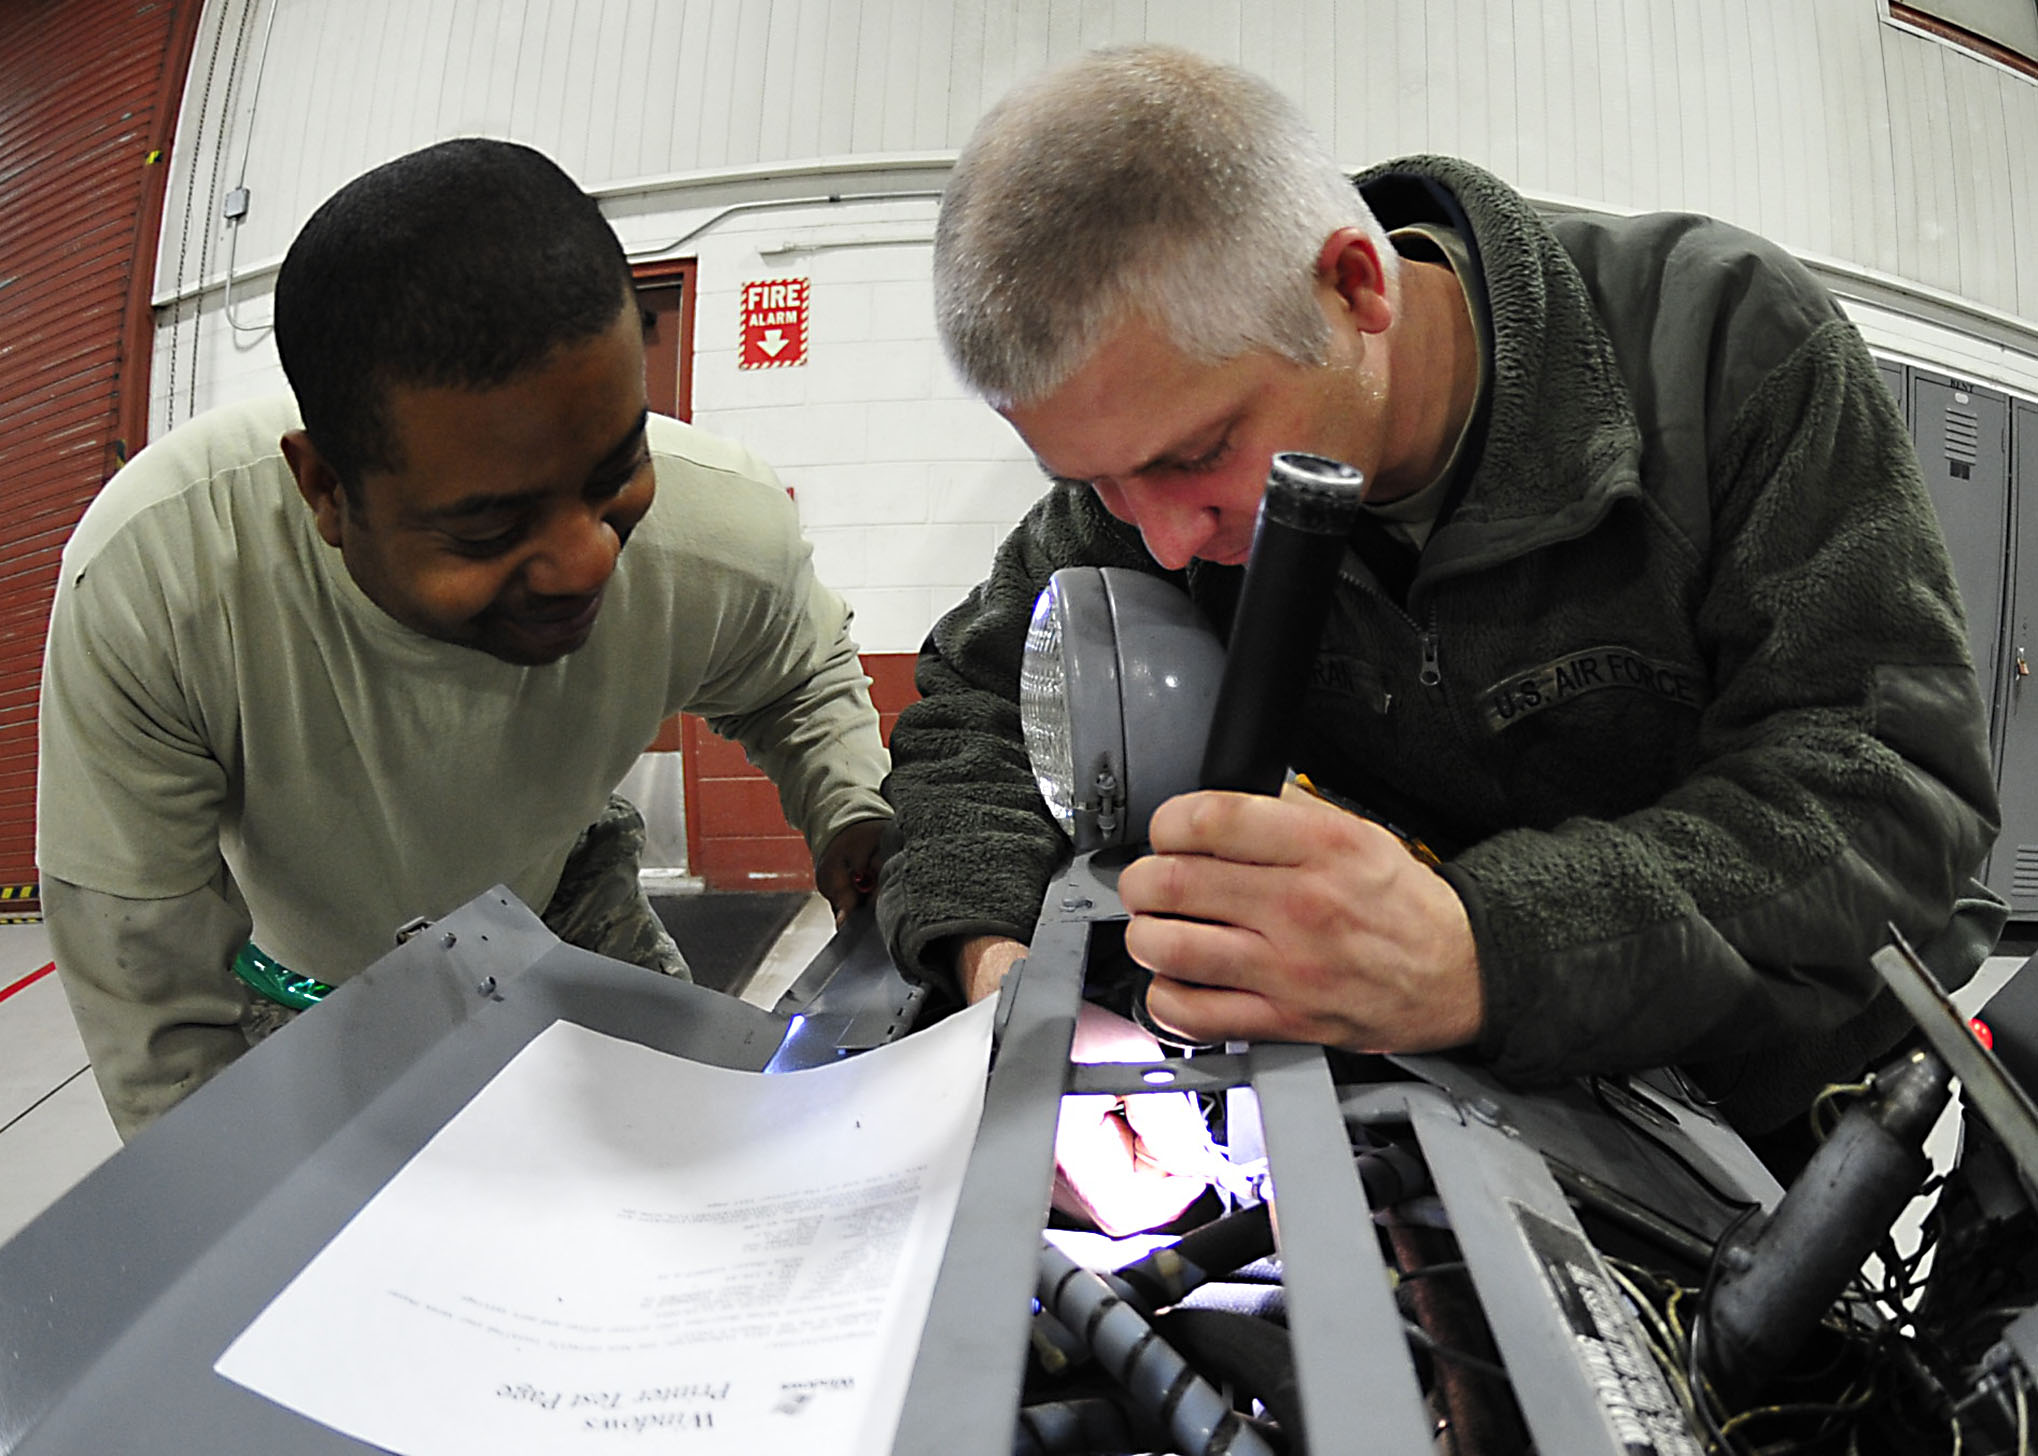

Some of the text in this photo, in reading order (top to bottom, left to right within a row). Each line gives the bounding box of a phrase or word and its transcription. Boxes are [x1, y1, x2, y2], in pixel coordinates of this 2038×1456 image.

[748, 284, 801, 311] FIRE
[749, 310, 798, 327] ALARM
[1494, 653, 1695, 721] U.S. AIR FORCE
[495, 1381, 731, 1411] Printer Test Page
[582, 1411, 714, 1433] Windows
